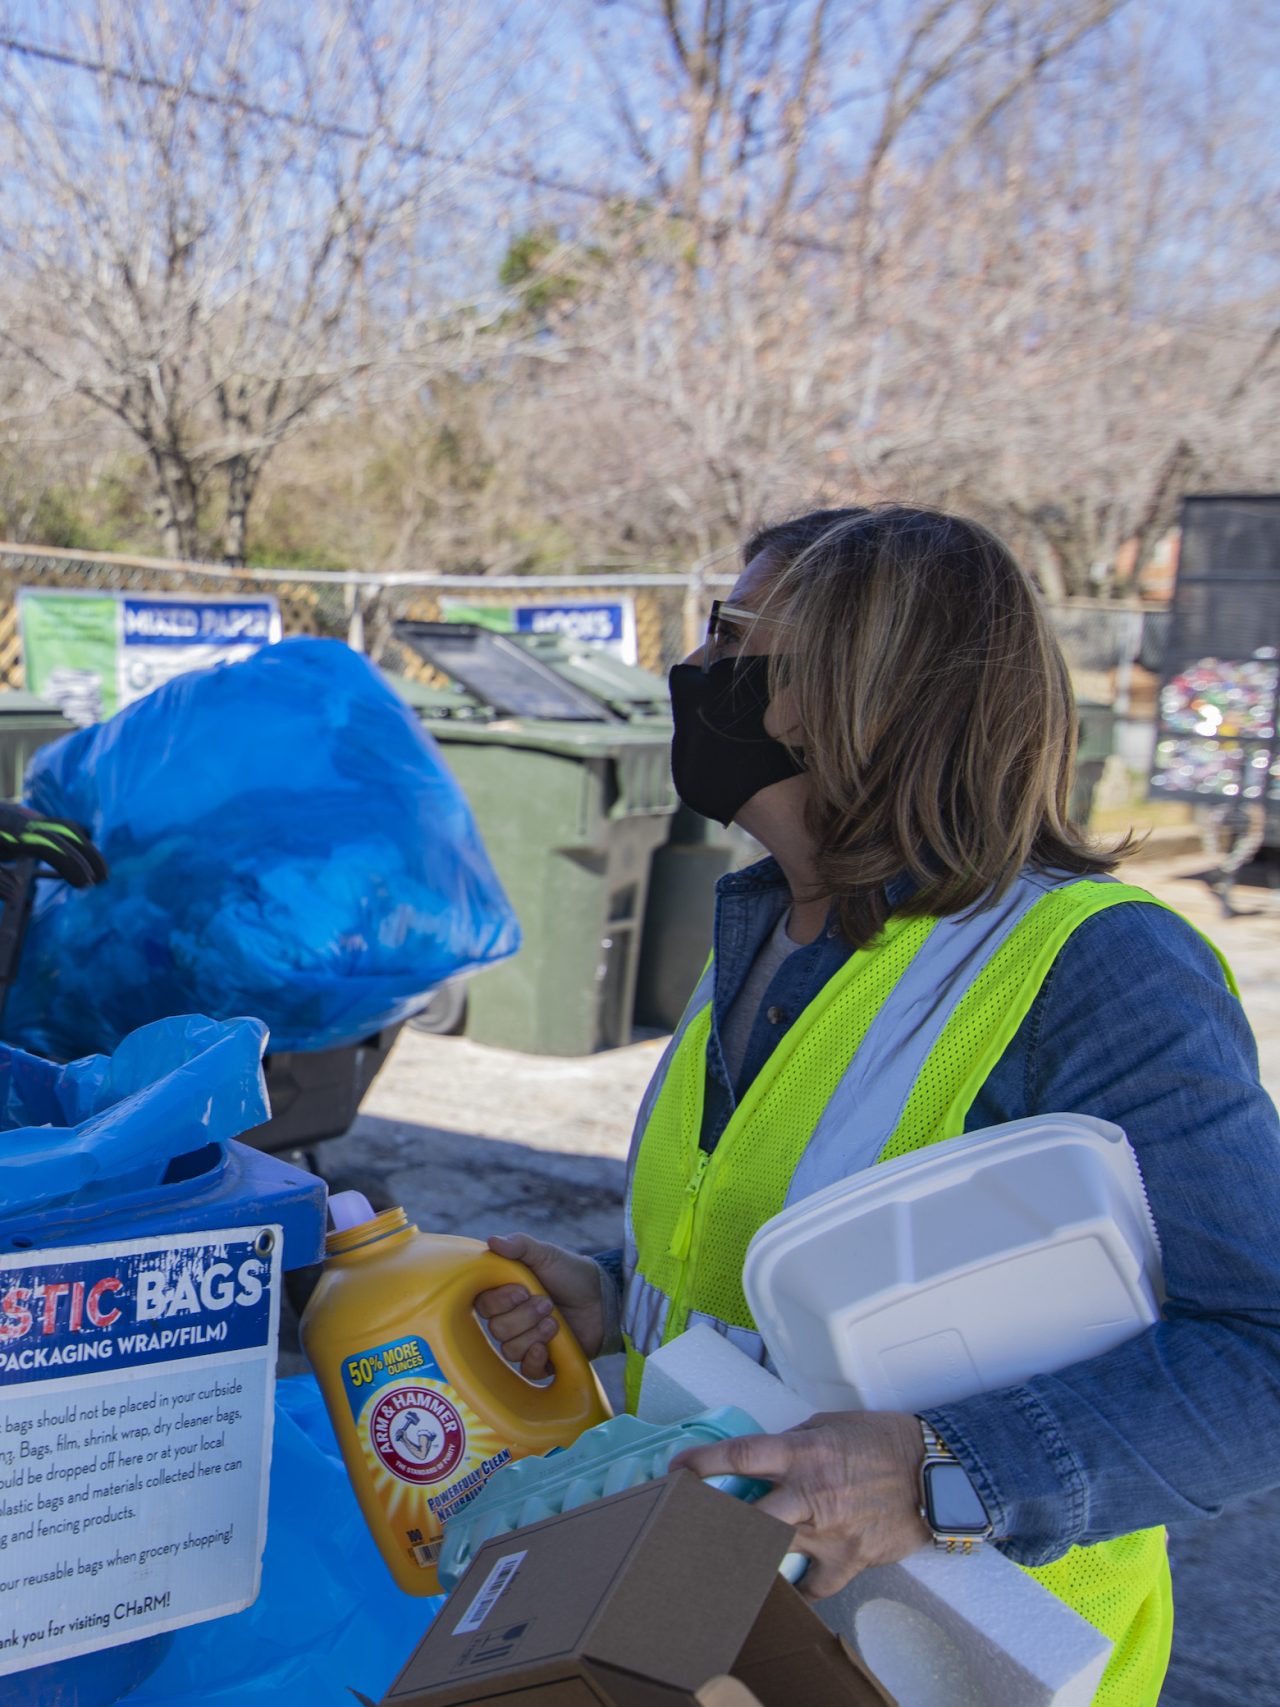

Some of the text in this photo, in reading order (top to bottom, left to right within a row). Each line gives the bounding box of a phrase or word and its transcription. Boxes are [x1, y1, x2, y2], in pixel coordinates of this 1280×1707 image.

[135, 1259, 263, 1322] BAGS
[117, 1321, 228, 1355] WRAP/FILM)
[348, 1340, 420, 1387] 50% MORE
[388, 1355, 424, 1376] OUNCES
[5, 1416, 33, 1435] bags
[37, 1405, 77, 1428] should
[80, 1406, 99, 1420] not
[102, 1400, 117, 1417] be
[120, 1392, 157, 1418] placed
[160, 1394, 169, 1407] in
[172, 1393, 196, 1409] your
[198, 1377, 243, 1400] curbside
[84, 1425, 118, 1447] shrink
[154, 1417, 173, 1436] dry
[175, 1413, 214, 1430] cleaner
[375, 1392, 458, 1454] ARM & HAMMER
[27, 1467, 43, 1485] be
[46, 1455, 97, 1482] dropped
[100, 1451, 116, 1471] off
[118, 1450, 143, 1467] here
[146, 1451, 158, 1462] or
[160, 1445, 172, 1458] at
[174, 1443, 198, 1461] your
[200, 1431, 225, 1451] local
[427, 1447, 512, 1512] POWERFULLY CLEAN
[37, 1492, 64, 1513] bags
[68, 1484, 89, 1503] and
[93, 1473, 143, 1499] materials
[146, 1462, 195, 1488] collected
[198, 1461, 221, 1477] here
[224, 1459, 243, 1472] can
[11, 1521, 34, 1542] and
[37, 1519, 80, 1537] fencing
[83, 1506, 136, 1532] products.
[23, 1560, 74, 1586] reusable
[77, 1557, 103, 1576] bags
[107, 1549, 137, 1567] when
[139, 1541, 181, 1564] grocery
[183, 1523, 234, 1550] shopping!
[22, 1629, 44, 1648] you
[47, 1620, 66, 1637] for
[69, 1613, 111, 1631] visiting
[114, 1591, 170, 1620] CHaRM!
